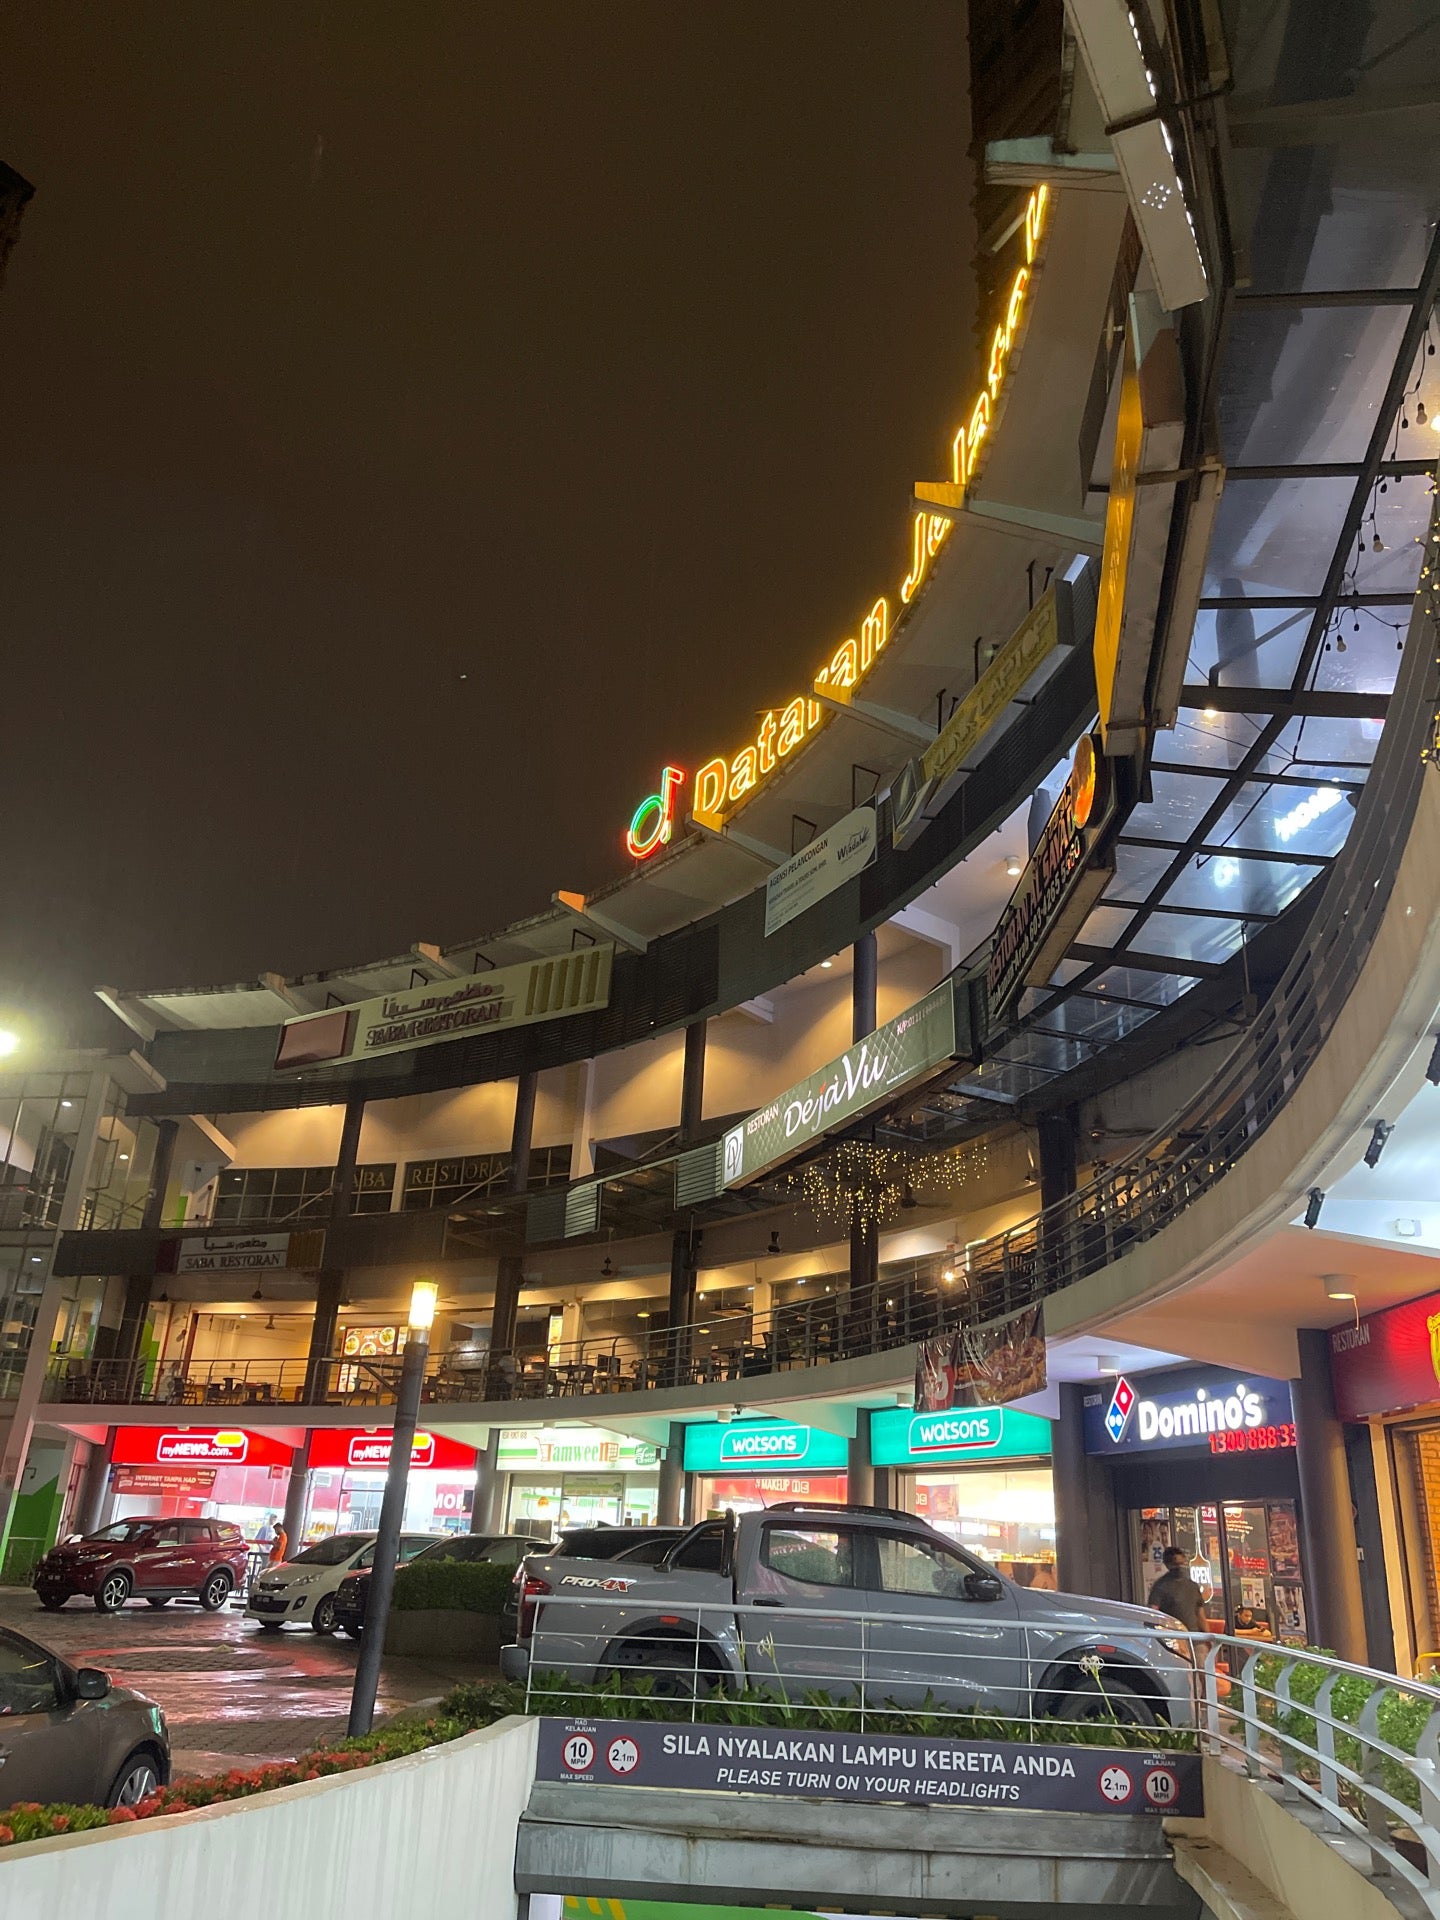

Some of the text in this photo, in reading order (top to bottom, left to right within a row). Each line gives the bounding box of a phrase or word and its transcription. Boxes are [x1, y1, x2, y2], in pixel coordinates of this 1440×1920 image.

[693, 597, 887, 814] Dataran
[841, 1043, 889, 1101] Vu
[747, 1103, 779, 1135] RESTORAN
[412, 1160, 507, 1185] RESTORA
[185, 1253, 280, 1269] SABA RESTORAN
[1332, 1323, 1370, 1354] RESTORAN
[1138, 1383, 1263, 1441] Domino's
[920, 1416, 990, 1443] watsons
[732, 1433, 797, 1453] watsons
[761, 1479, 790, 1492] MAKEUP
[560, 1575, 638, 1593] PRO-4X
[1190, 1566, 1210, 1584] OPEN
[565, 1725, 597, 1733] KELAJUAN
[569, 1741, 588, 1759] 10
[611, 1749, 635, 1762] 2.1m
[662, 1734, 1076, 1778] SILA NYALAKAN LAMPU KERETA ANDA
[570, 1758, 587, 1766] MPH
[1143, 1759, 1176, 1767] KELAJUAN
[716, 1768, 1020, 1801] PLEASE TURN ON YOUR HEADLIGHTS
[1104, 1777, 1128, 1792] 2.1m
[1150, 1776, 1170, 1793] 10
[1152, 1791, 1170, 1800] MPH
